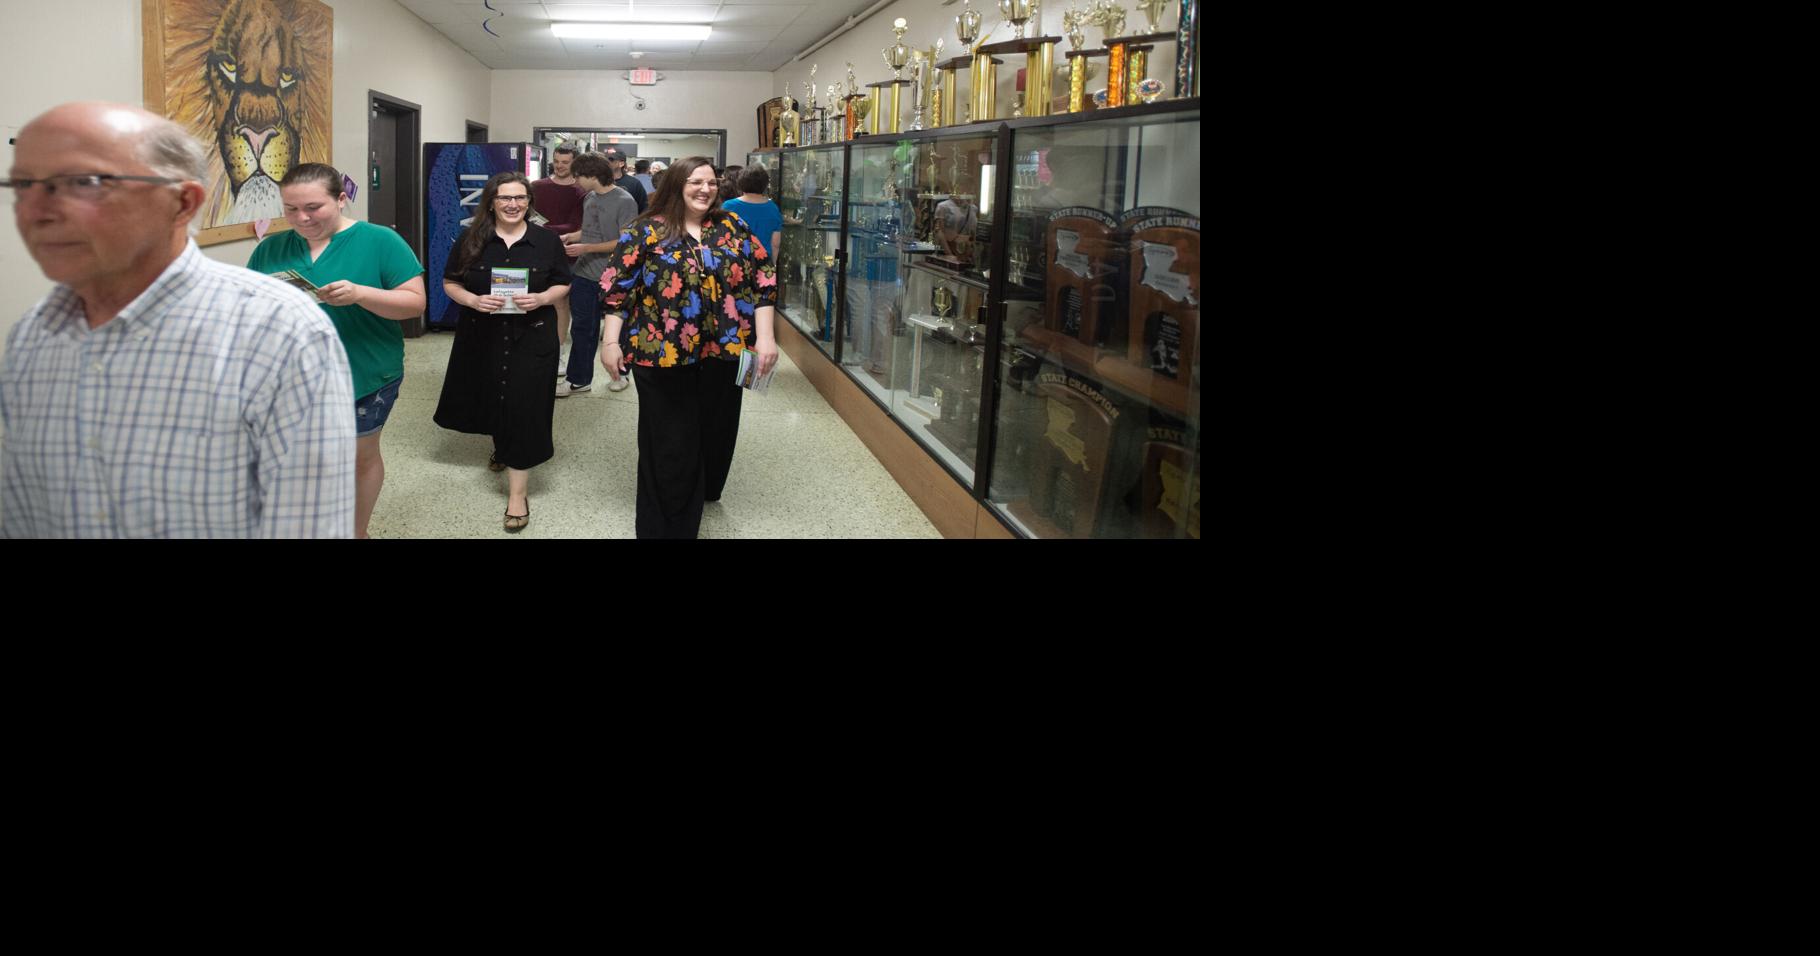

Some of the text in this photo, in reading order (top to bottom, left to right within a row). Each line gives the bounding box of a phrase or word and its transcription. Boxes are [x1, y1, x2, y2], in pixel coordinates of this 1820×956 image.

[1049, 208, 1071, 222] STATE
[1133, 217, 1163, 233] STATE
[1040, 372, 1120, 419] STATE CHAMPION
